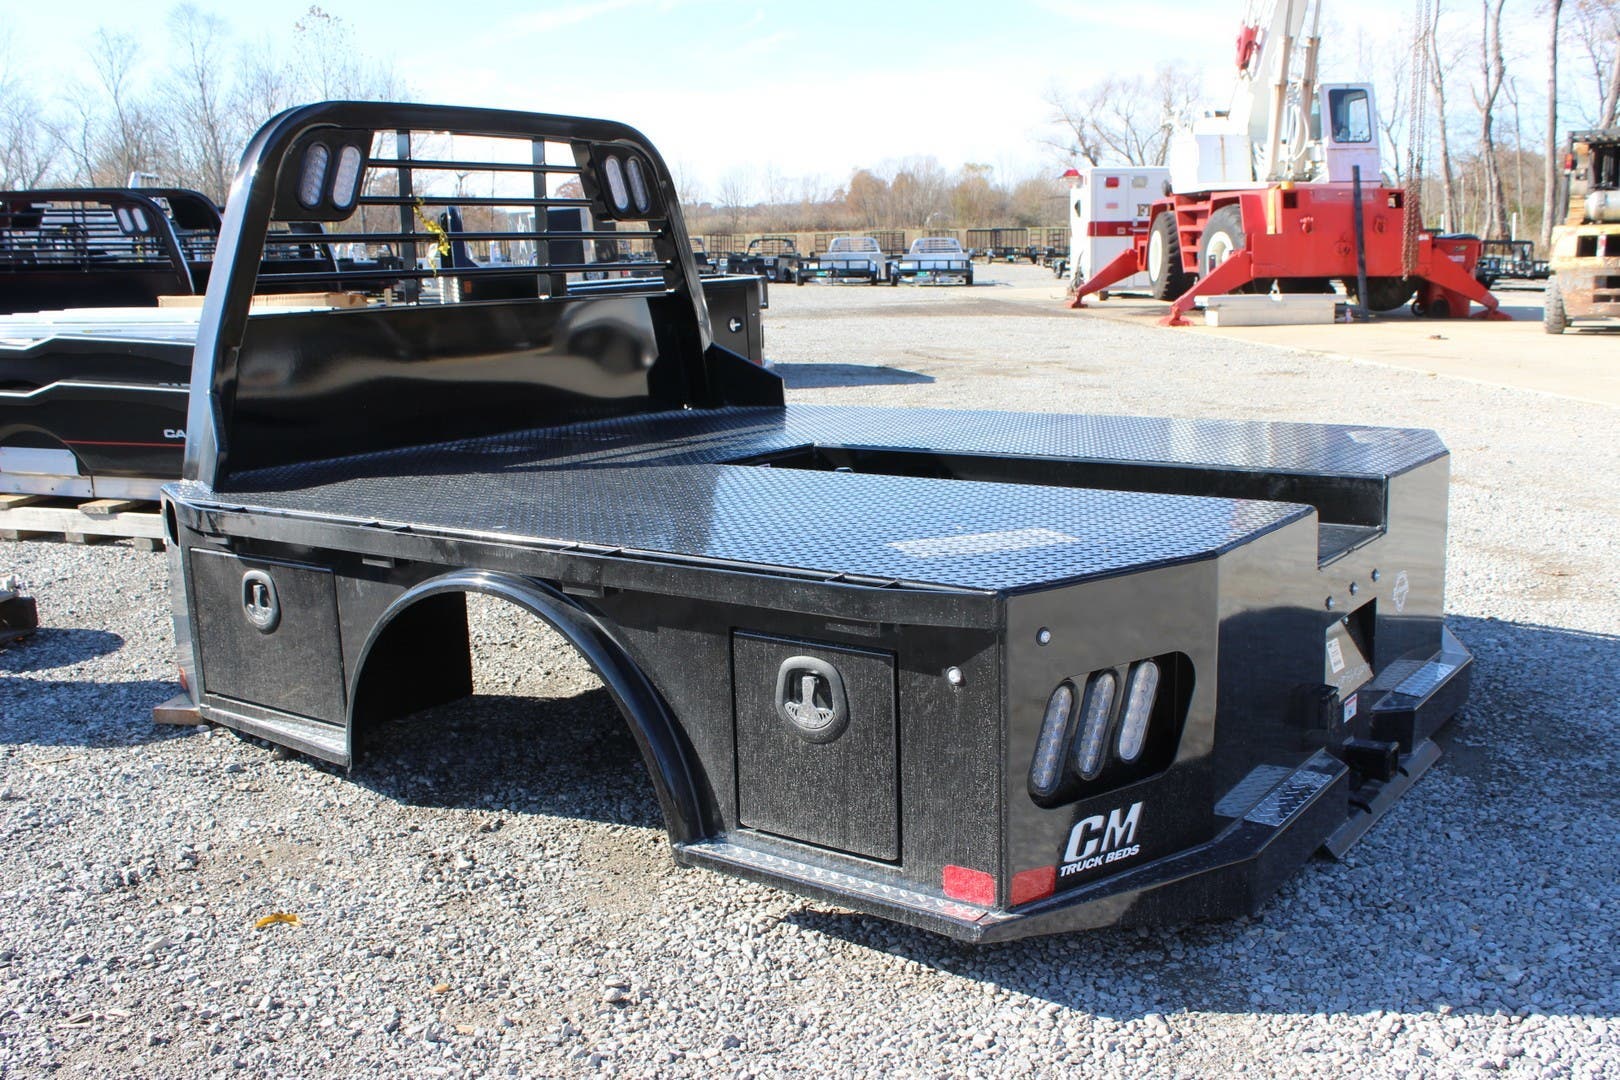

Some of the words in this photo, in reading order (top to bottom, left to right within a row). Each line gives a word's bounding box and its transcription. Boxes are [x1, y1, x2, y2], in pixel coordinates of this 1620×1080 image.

[1063, 801, 1143, 863] CM
[1060, 854, 1106, 878] TRUCK
[1105, 844, 1141, 864] BEDS
